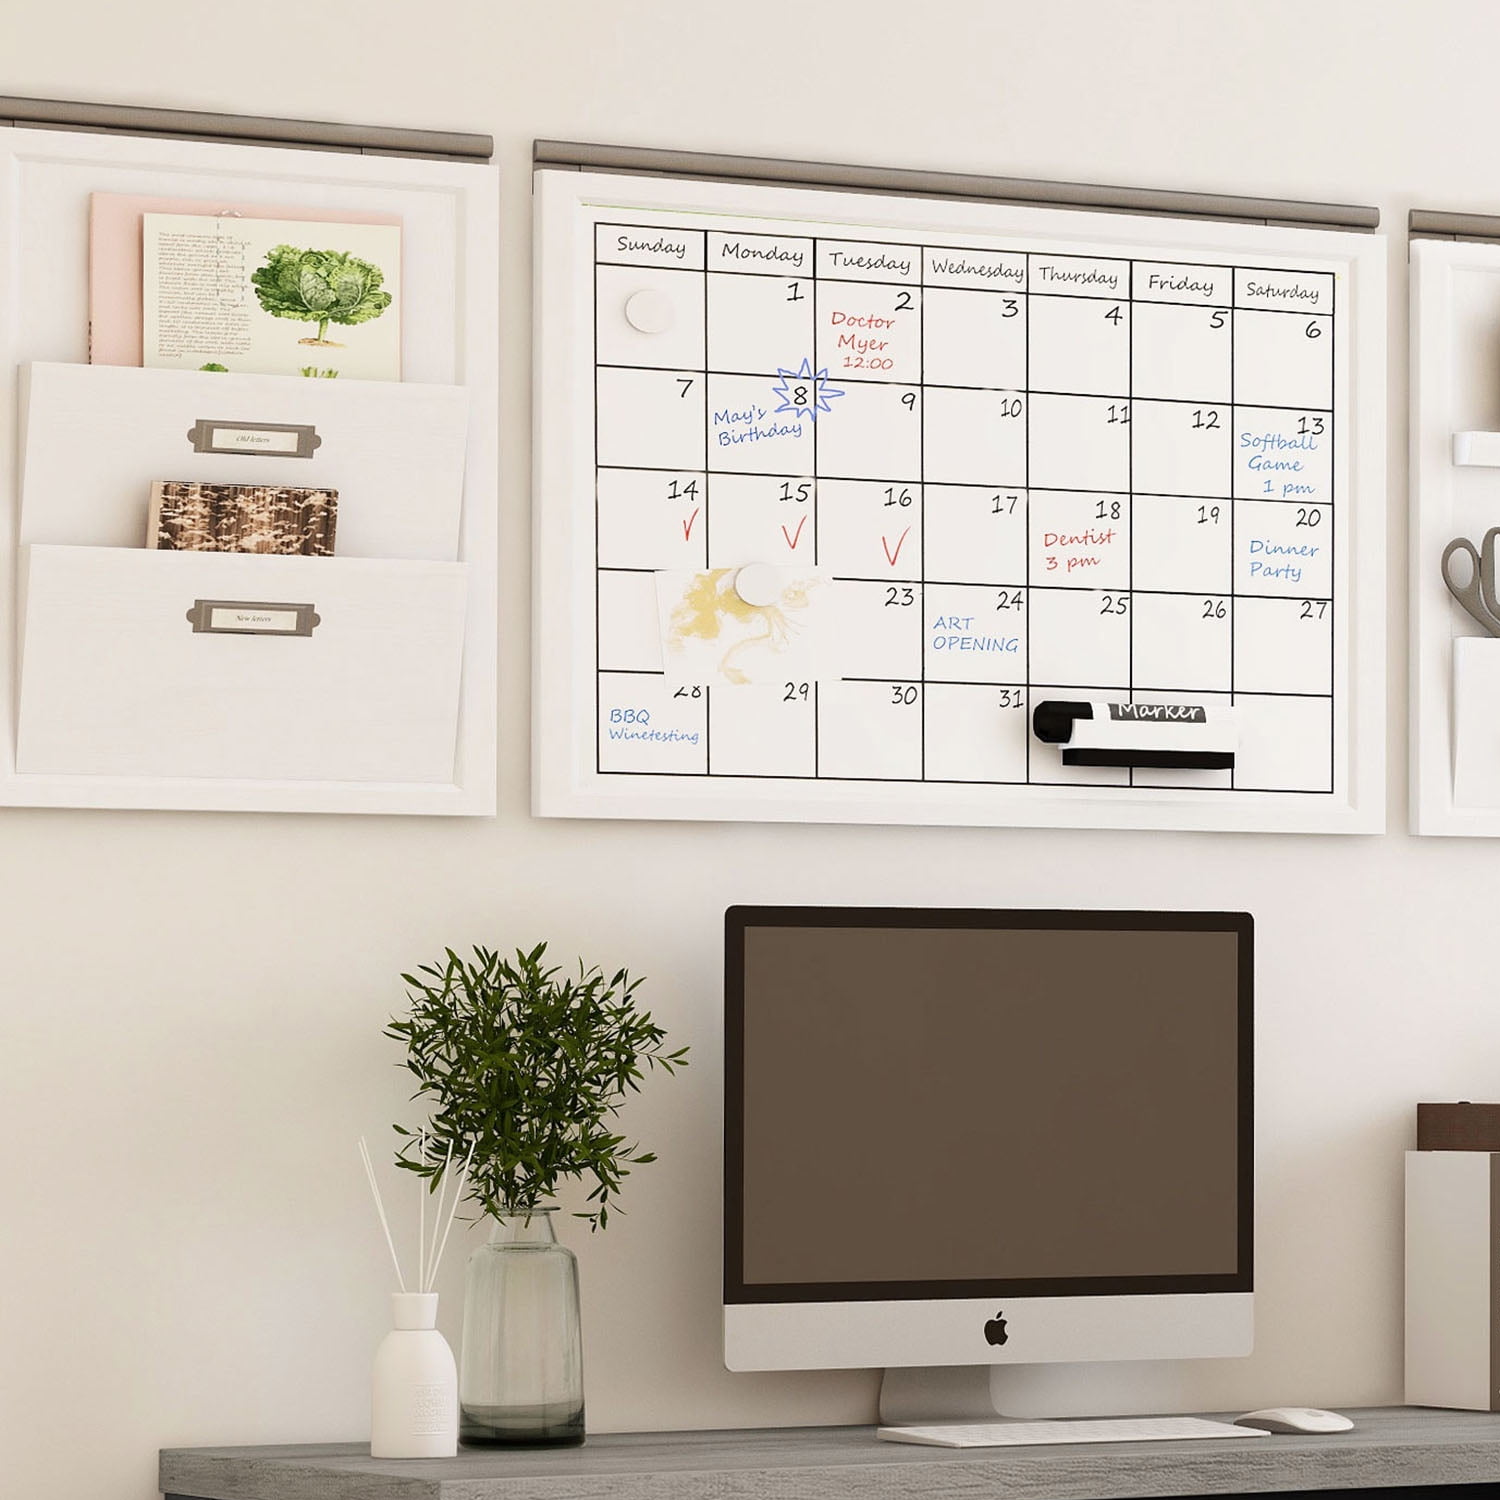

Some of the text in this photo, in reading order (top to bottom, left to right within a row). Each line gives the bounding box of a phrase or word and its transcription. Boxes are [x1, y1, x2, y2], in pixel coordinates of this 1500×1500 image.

[618, 236, 685, 259] Sunday
[722, 243, 803, 267] Monday
[829, 252, 910, 275] Tuesday
[933, 260, 1023, 283] Wednesday
[1040, 267, 1117, 289] Thursday
[1149, 275, 1213, 296] Friday
[787, 283, 804, 301] 1
[895, 292, 914, 311] 2
[1248, 282, 1318, 304] Saturday
[1002, 299, 1018, 317] 3
[1105, 306, 1123, 325] 4
[830, 311, 896, 330] Doctor
[1210, 311, 1228, 328] 5
[1306, 321, 1321, 338] 6
[837, 334, 889, 355] Myer
[842, 356, 894, 371] 12:00
[677, 379, 693, 398] 7
[794, 386, 808, 405] 8
[902, 393, 915, 411] 9
[1001, 399, 1021, 417] 10
[713, 406, 767, 426] May's
[1108, 404, 1131, 426] 11
[1193, 410, 1220, 429] 12
[718, 422, 803, 447] Birthday
[1298, 417, 1324, 435] 13
[1240, 432, 1319, 452] Softball
[1247, 455, 1304, 473] Game
[668, 480, 698, 501] 14
[780, 482, 811, 502] 15
[885, 488, 911, 507] 16
[1262, 480, 1316, 498] 1 pm
[992, 495, 1017, 514] 17
[1096, 501, 1120, 519] 18
[1198, 506, 1219, 523] 19
[1296, 508, 1321, 527] 20
[1043, 528, 1117, 549] Dentist
[1248, 539, 1320, 558] Dinner
[1045, 554, 1101, 574] 3 pm
[1248, 561, 1303, 583] Party
[885, 587, 913, 606] 23
[997, 591, 1023, 611] 24
[1101, 596, 1129, 614] 25
[1203, 600, 1226, 618] 26
[1301, 601, 1327, 619] 27
[932, 616, 976, 632] ART
[932, 636, 1019, 654] OPENING
[784, 682, 809, 701] 29
[892, 687, 917, 704] 30
[1000, 690, 1023, 708] 31
[609, 708, 651, 726] BBQ
[1118, 703, 1202, 722] Marker
